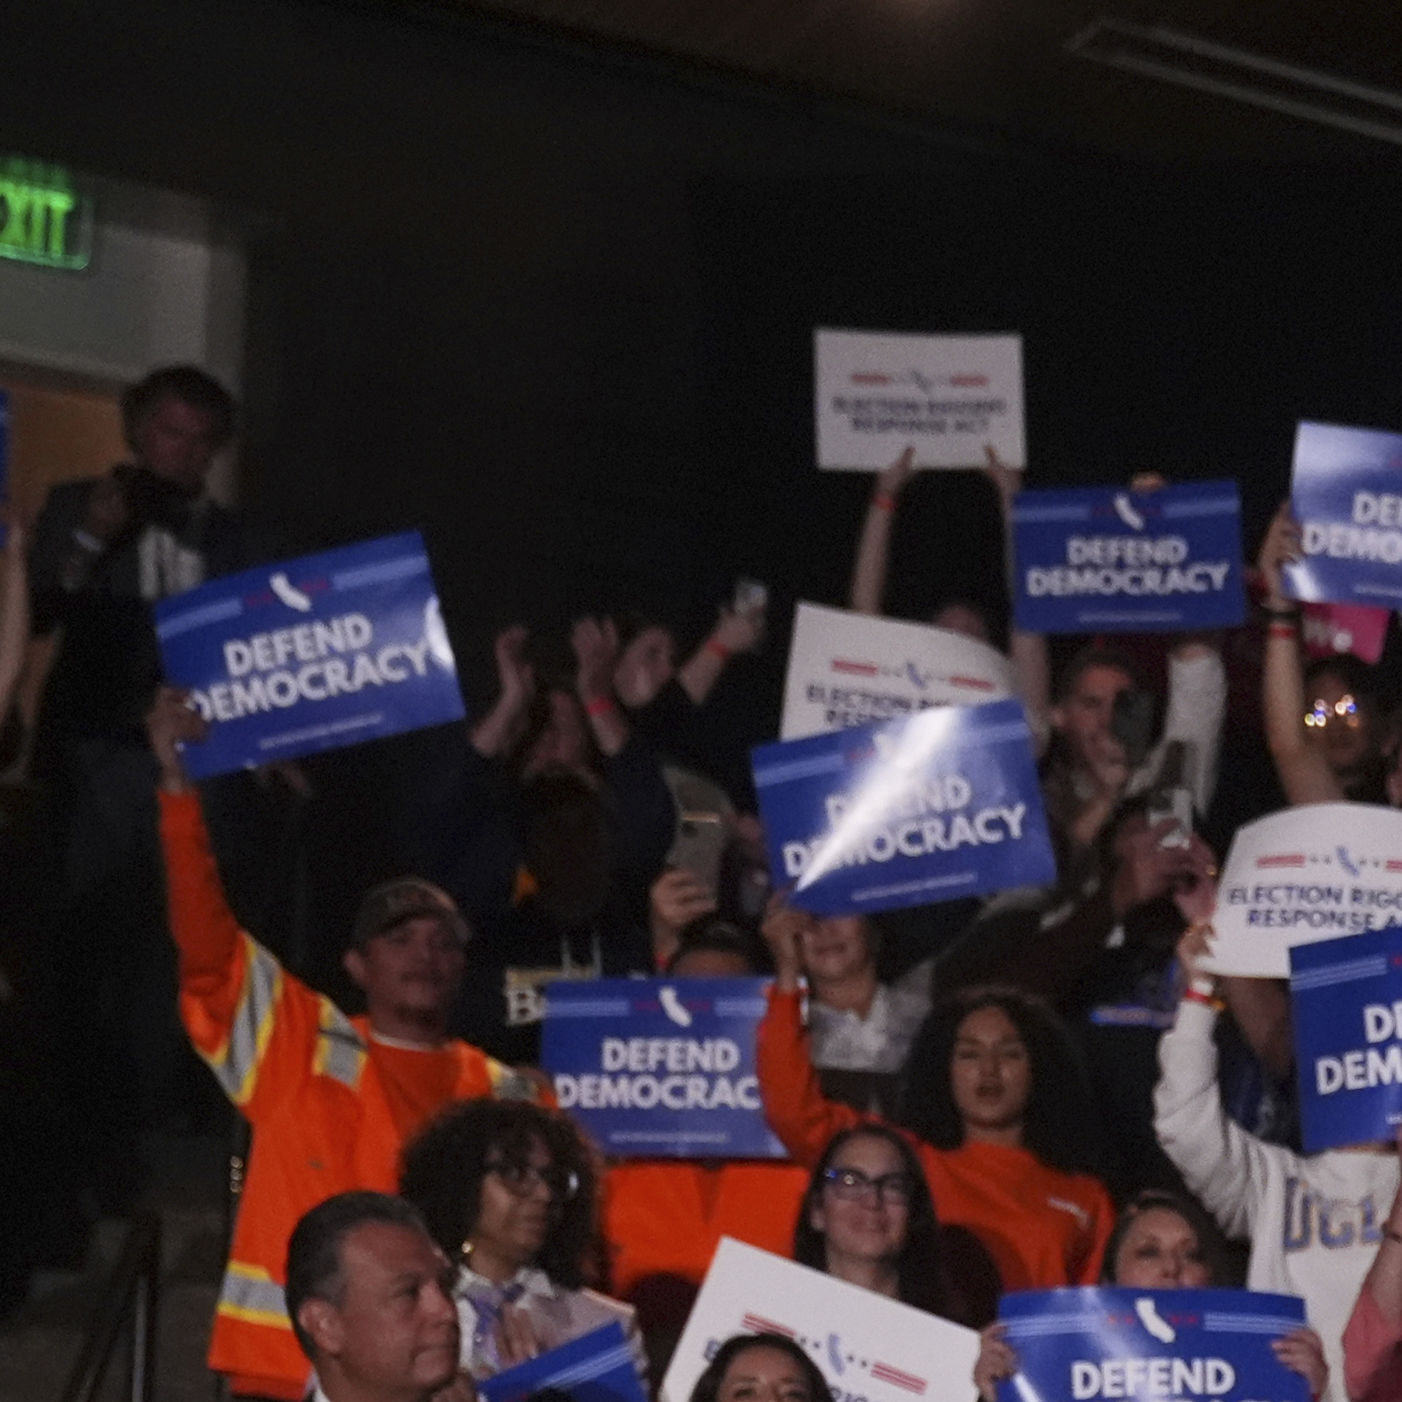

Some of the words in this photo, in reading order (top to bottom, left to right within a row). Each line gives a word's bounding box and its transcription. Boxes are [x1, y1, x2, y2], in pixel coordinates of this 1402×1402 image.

[0, 183, 74, 254] XIT
[1066, 536, 1190, 566] DEFEND
[1026, 563, 1231, 598] DEMOCRACY
[223, 612, 374, 678] DEFEND
[1229, 885, 1344, 907] ELECTION
[1248, 907, 1375, 930] RESPONSE
[601, 1036, 740, 1074] DEFEND
[556, 1074, 762, 1110] DEMOCRAC
[1282, 1176, 1385, 1253] UCL
[1070, 1357, 1236, 1400] DEFEND
